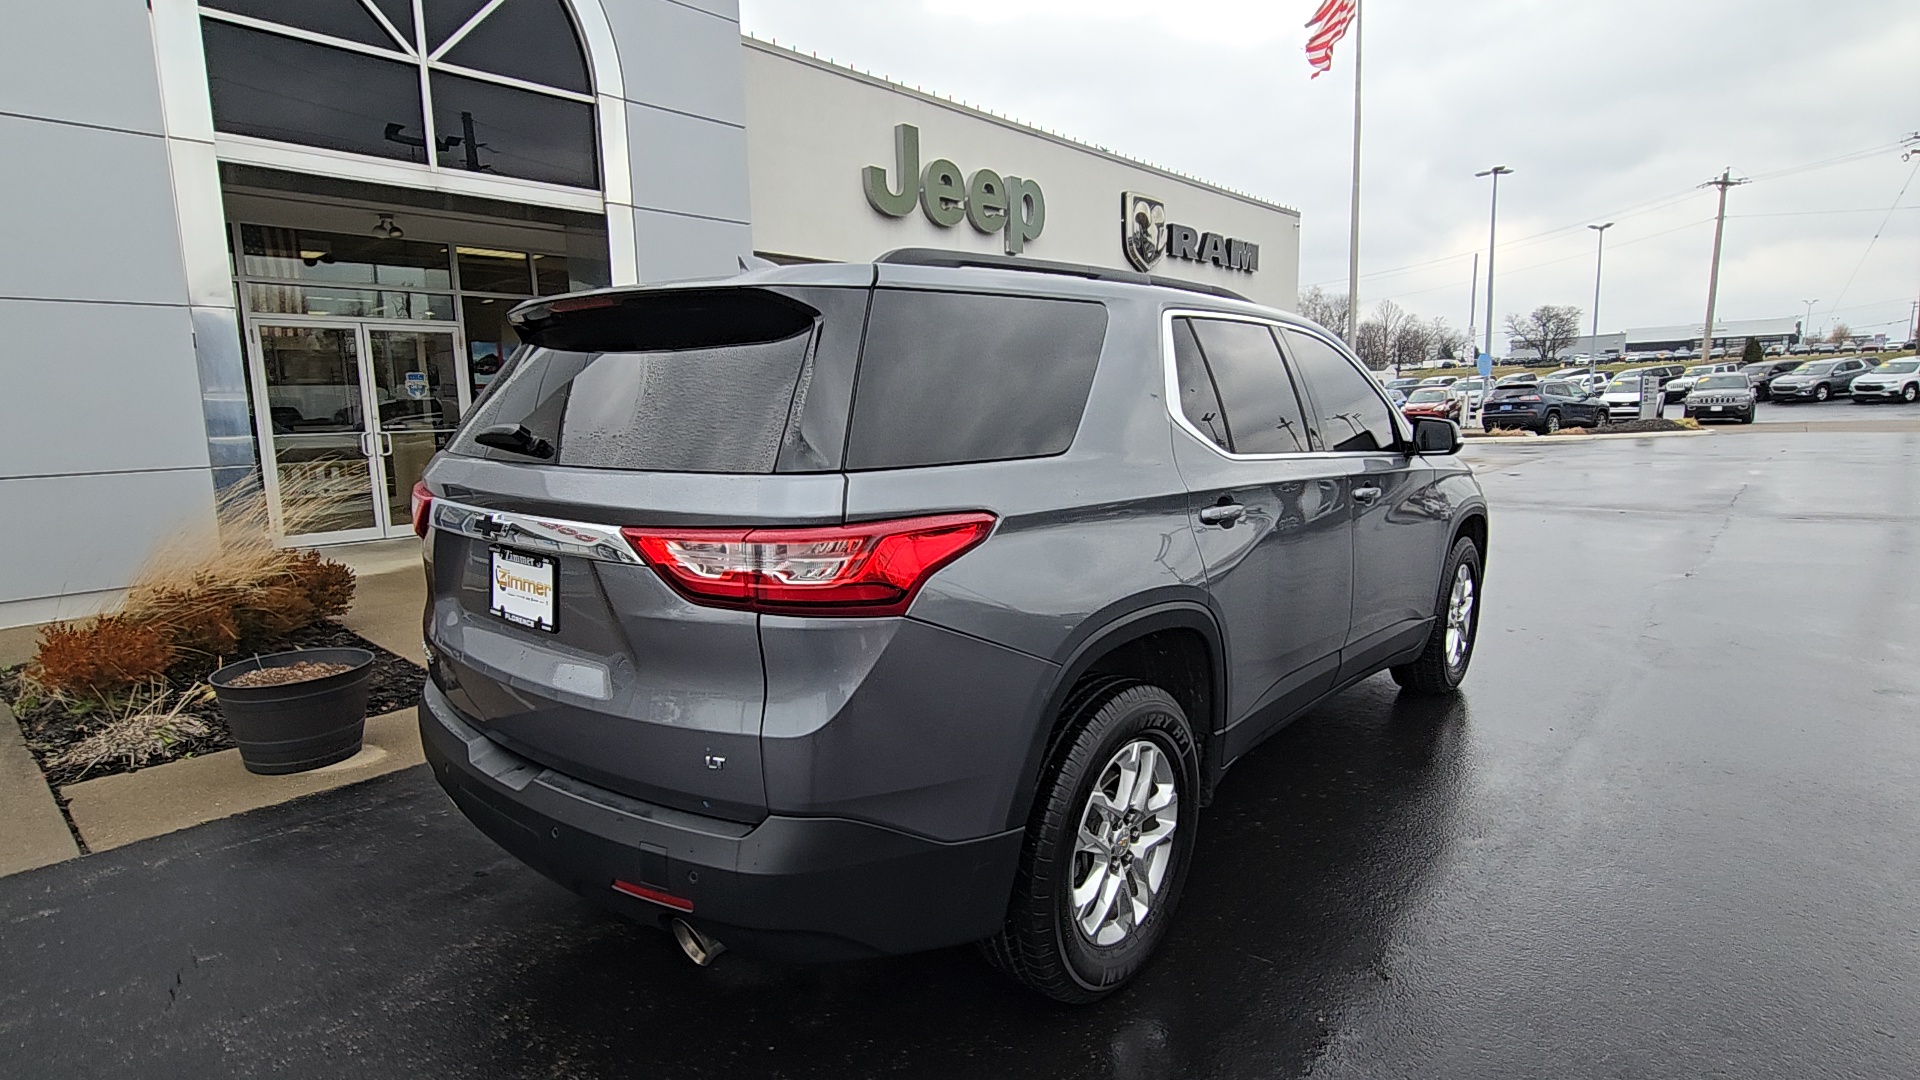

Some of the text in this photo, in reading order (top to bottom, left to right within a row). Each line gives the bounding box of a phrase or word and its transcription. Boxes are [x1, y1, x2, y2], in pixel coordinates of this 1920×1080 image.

[862, 123, 1046, 255] Jeep
[1166, 222, 1260, 273] RAM
[506, 550, 535, 566] Zimmer
[498, 568, 551, 597] Zimmer
[705, 755, 726, 769] LT
